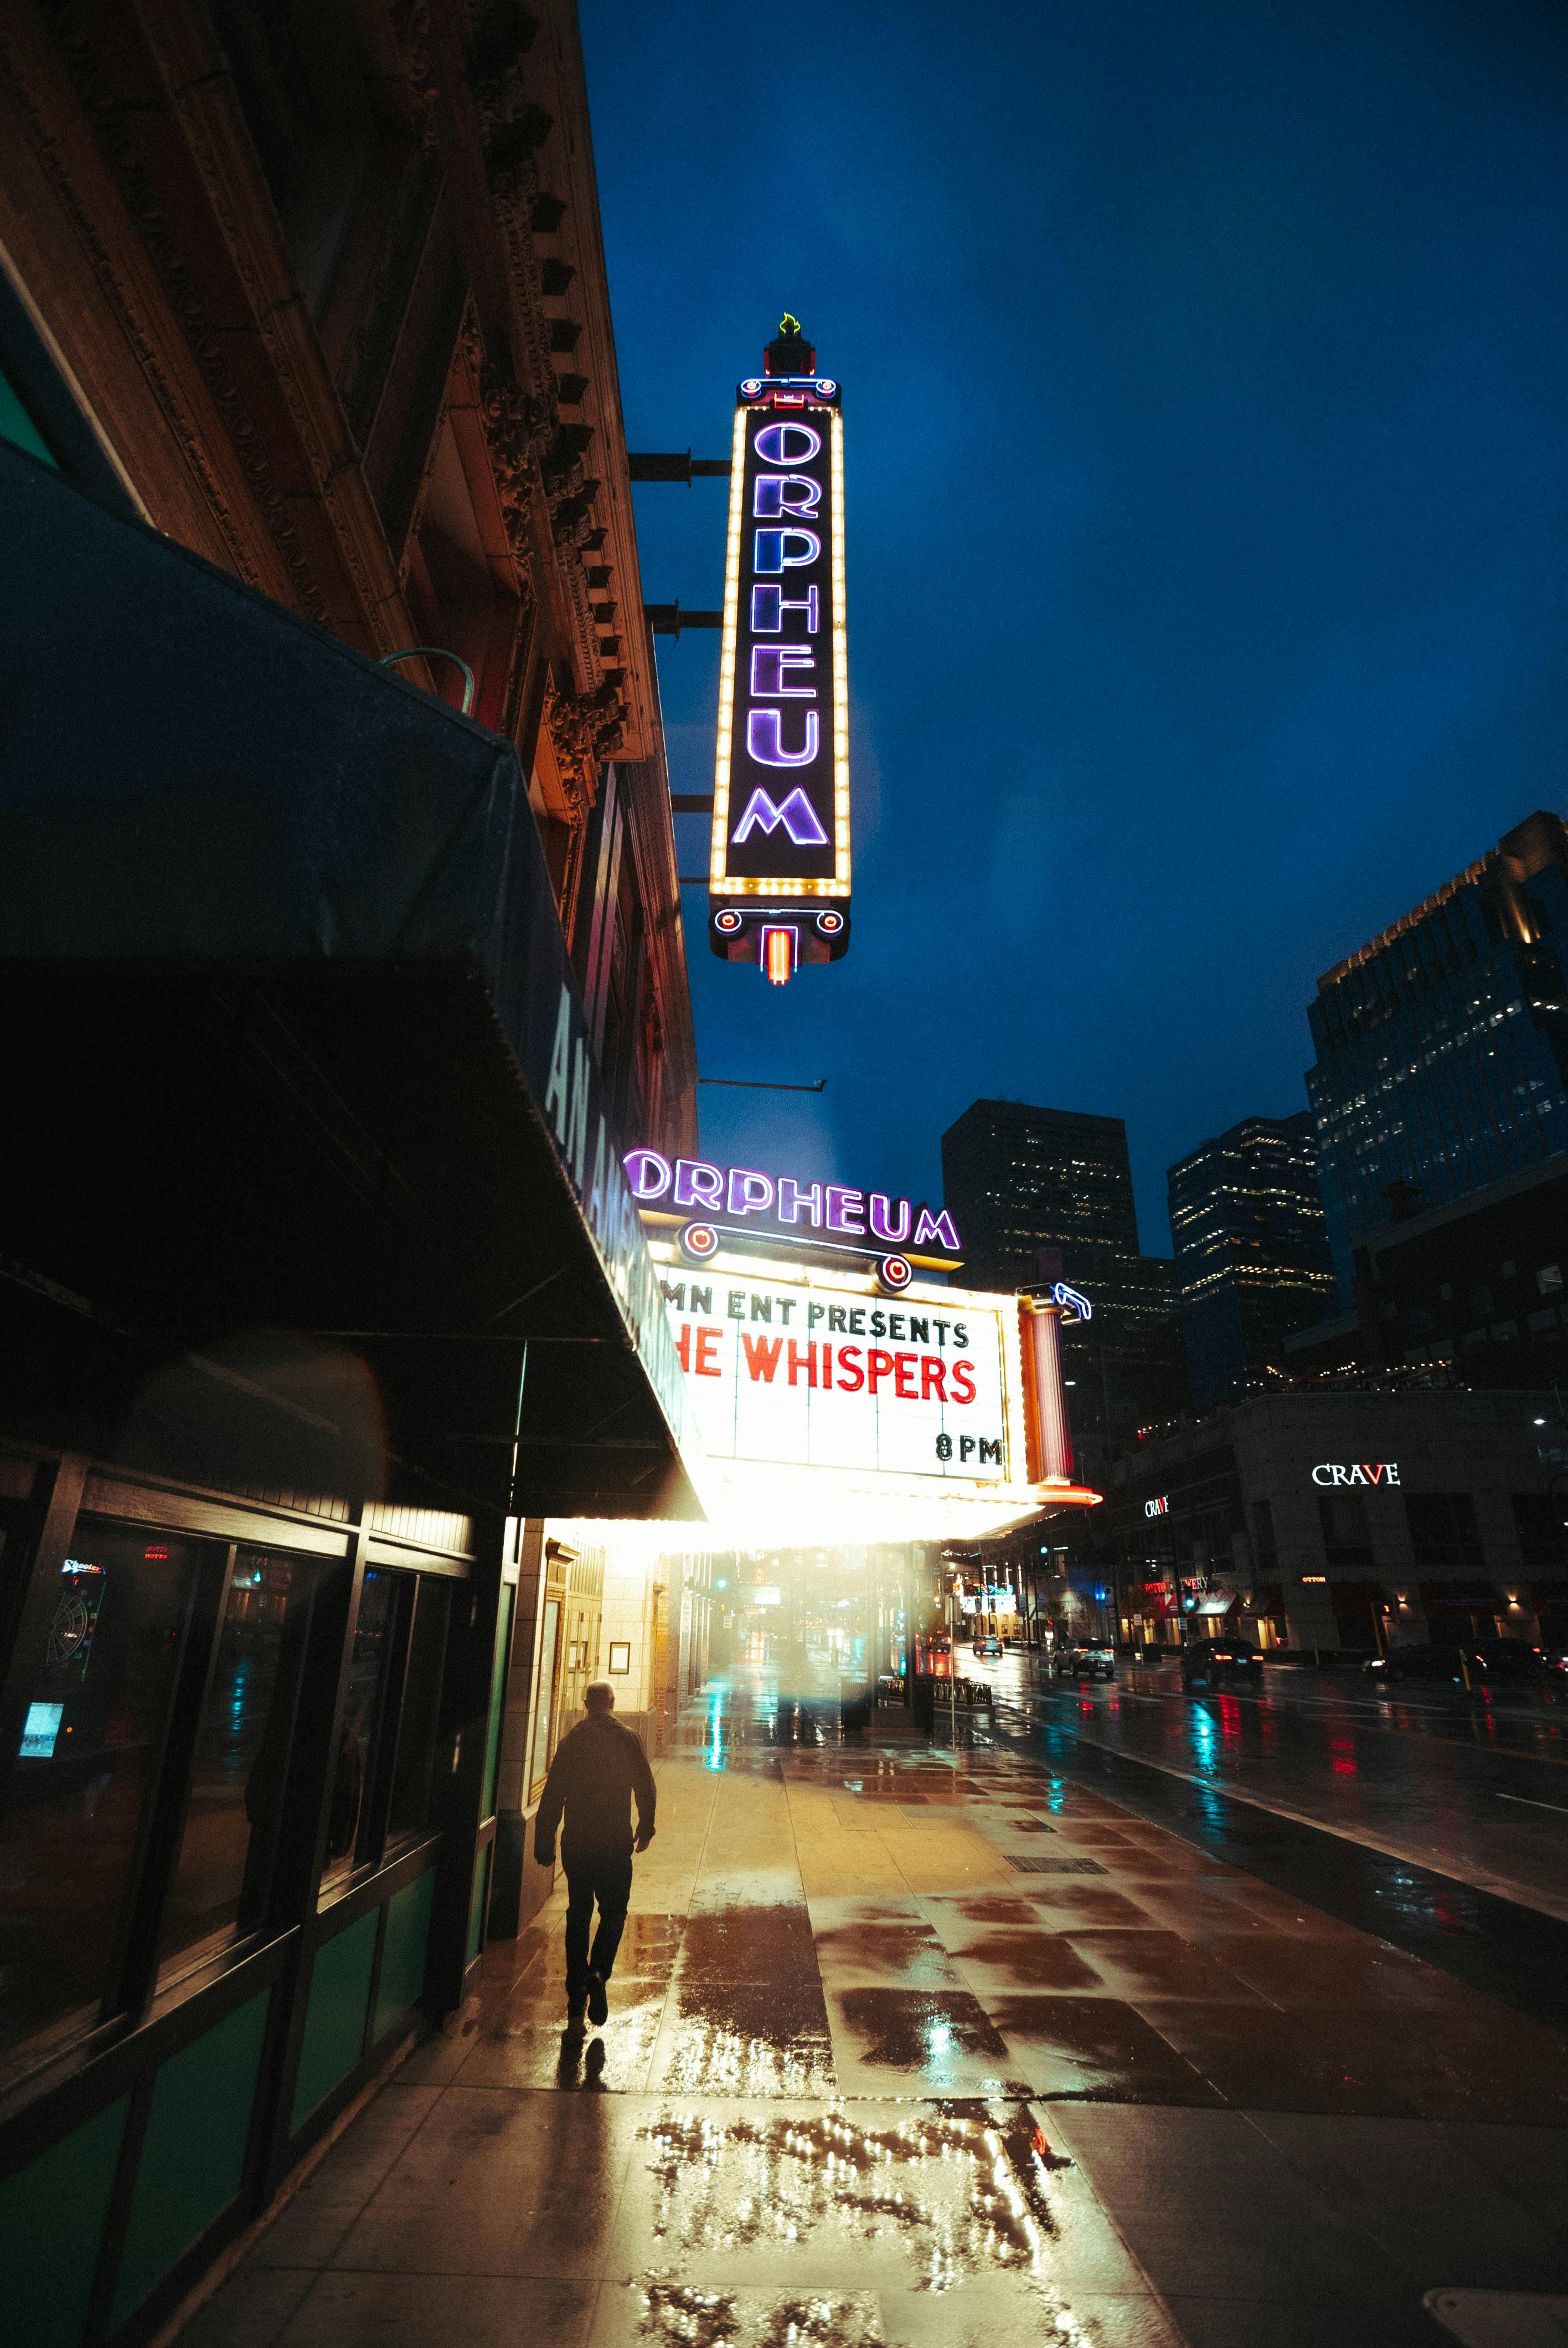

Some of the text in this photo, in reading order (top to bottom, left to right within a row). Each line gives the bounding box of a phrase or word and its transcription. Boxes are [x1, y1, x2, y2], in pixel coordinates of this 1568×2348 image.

[730, 420, 829, 846] ORPHEUM
[622, 1147, 962, 1251] ORPHEUM
[728, 1291, 796, 1325] ENT
[808, 1301, 969, 1348] PRESENTS
[741, 1332, 976, 1404] WHISPERS
[936, 1433, 1003, 1465] 8 PM
[1312, 1463, 1401, 1486] CRAVE
[1145, 1495, 1169, 1518] CRAVE
